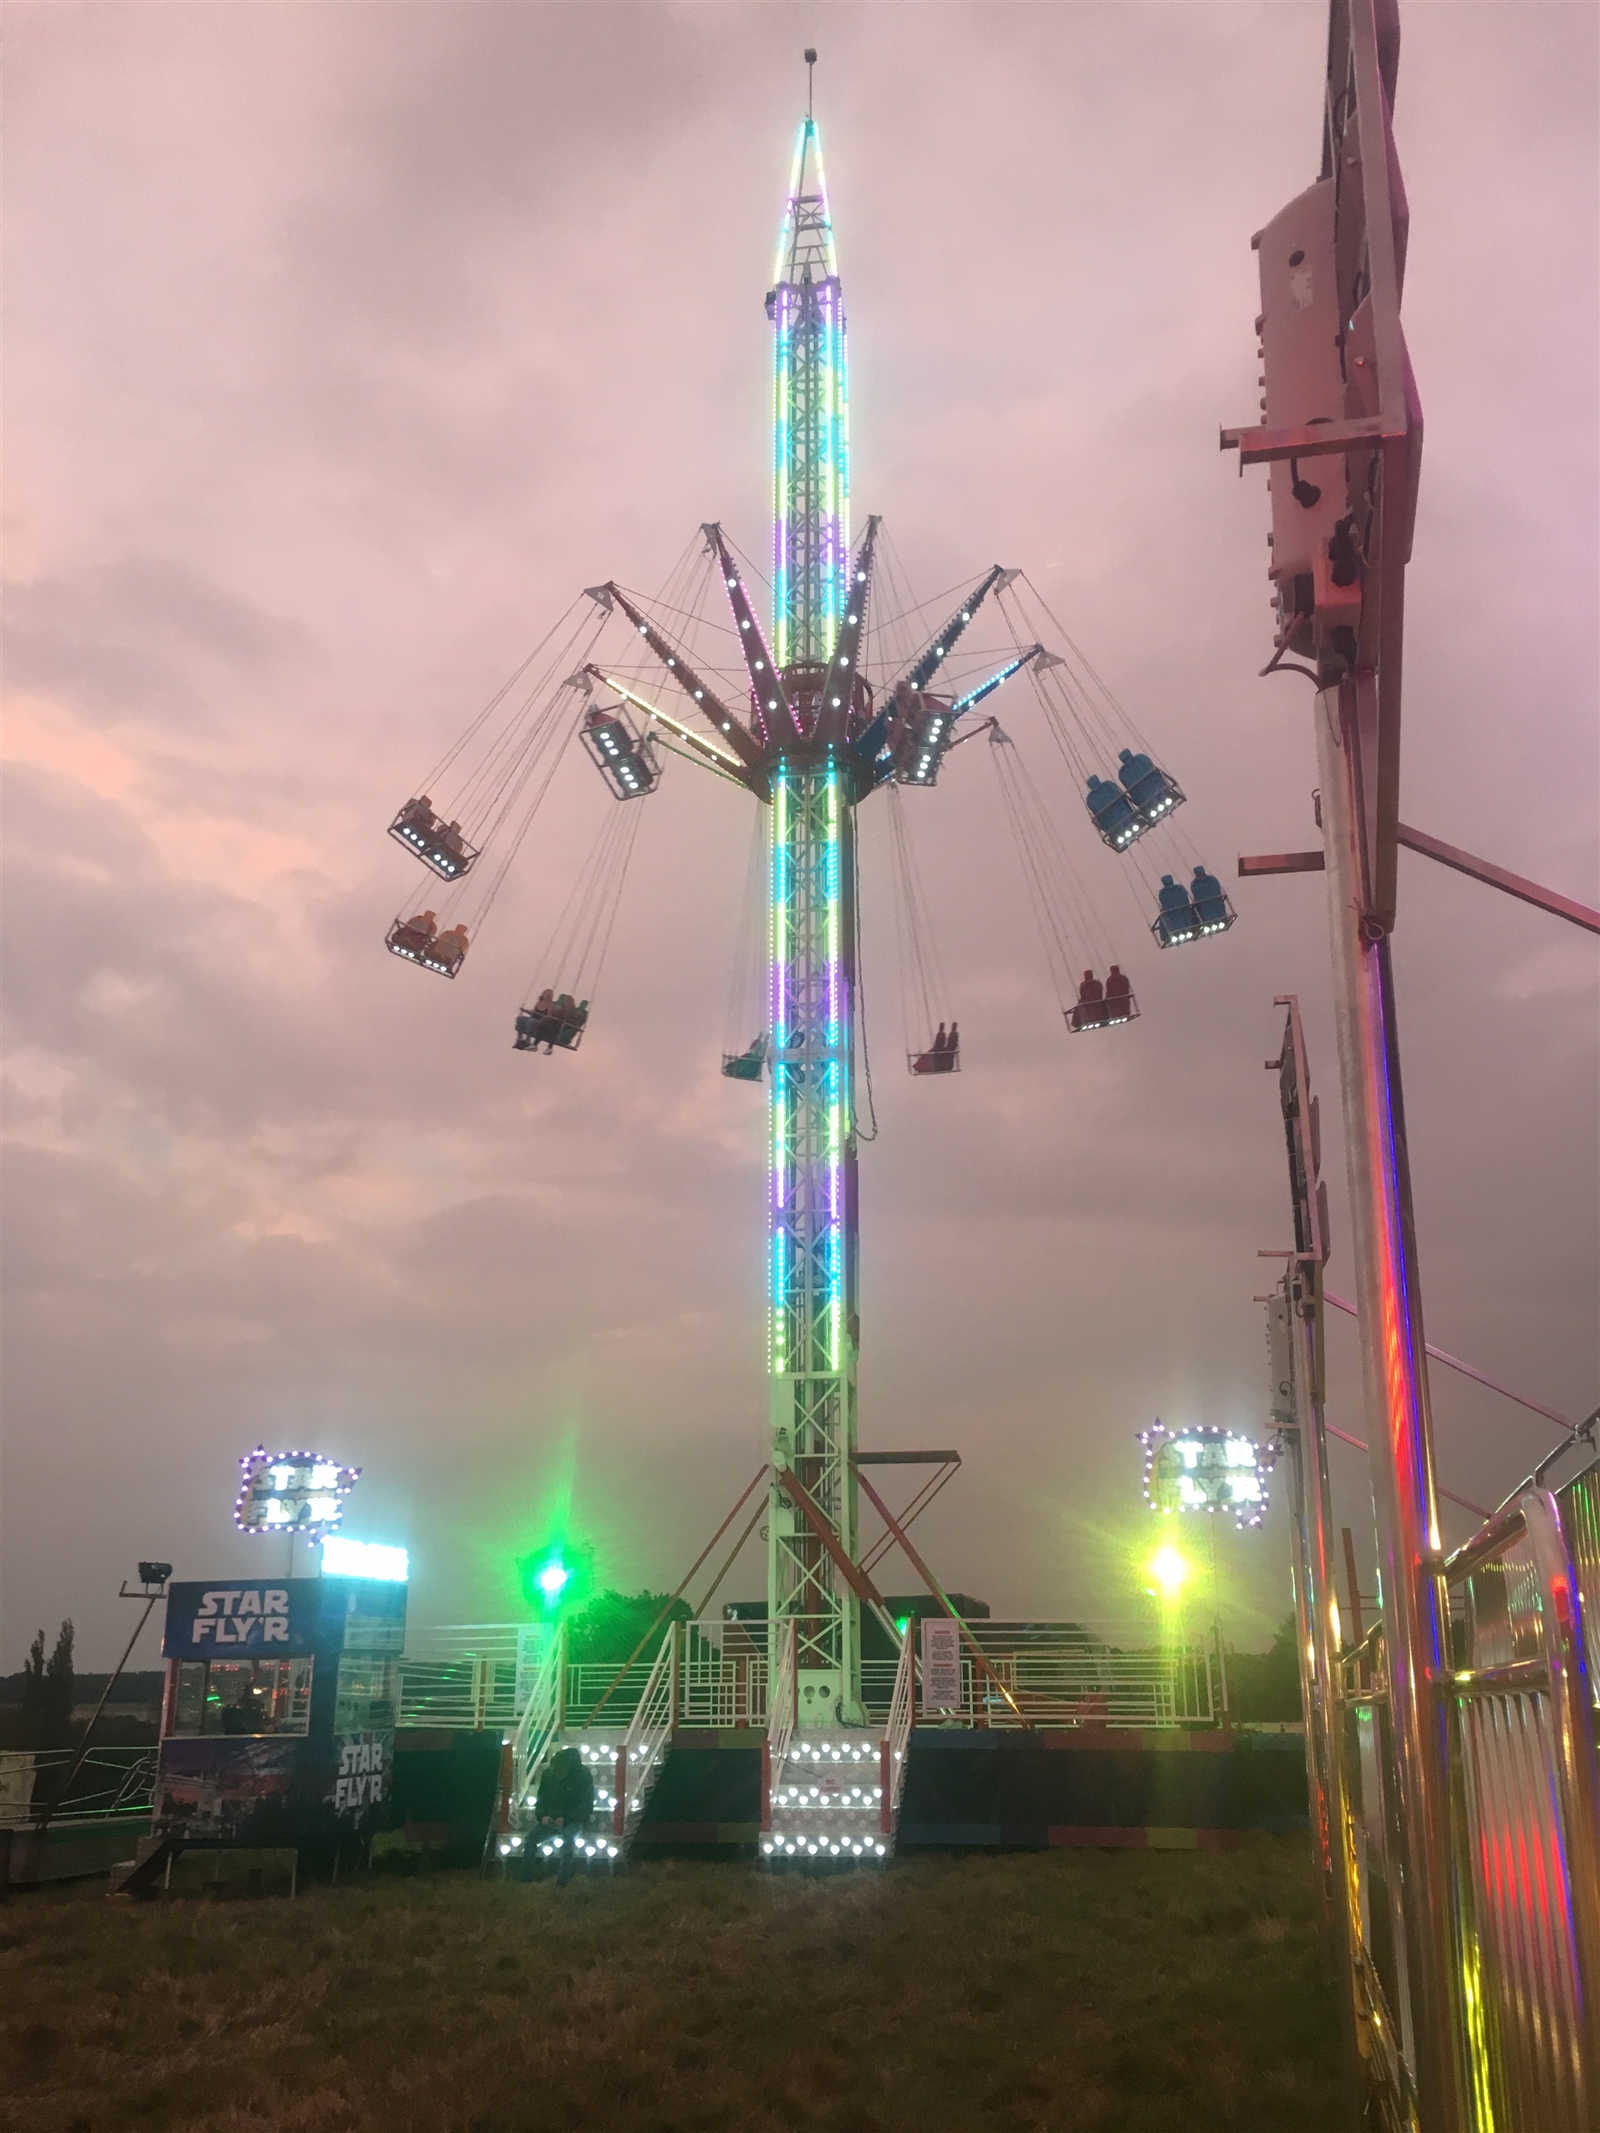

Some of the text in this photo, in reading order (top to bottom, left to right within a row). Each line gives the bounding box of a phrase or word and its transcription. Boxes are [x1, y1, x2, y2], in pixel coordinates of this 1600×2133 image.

[1158, 1441, 1257, 1468] STAR
[254, 1465, 338, 1490] STAR
[198, 1589, 290, 1616] STAR
[191, 1616, 290, 1644] FLY'R
[338, 1743, 384, 1775] STAR
[334, 1774, 384, 1810] FLY'R
